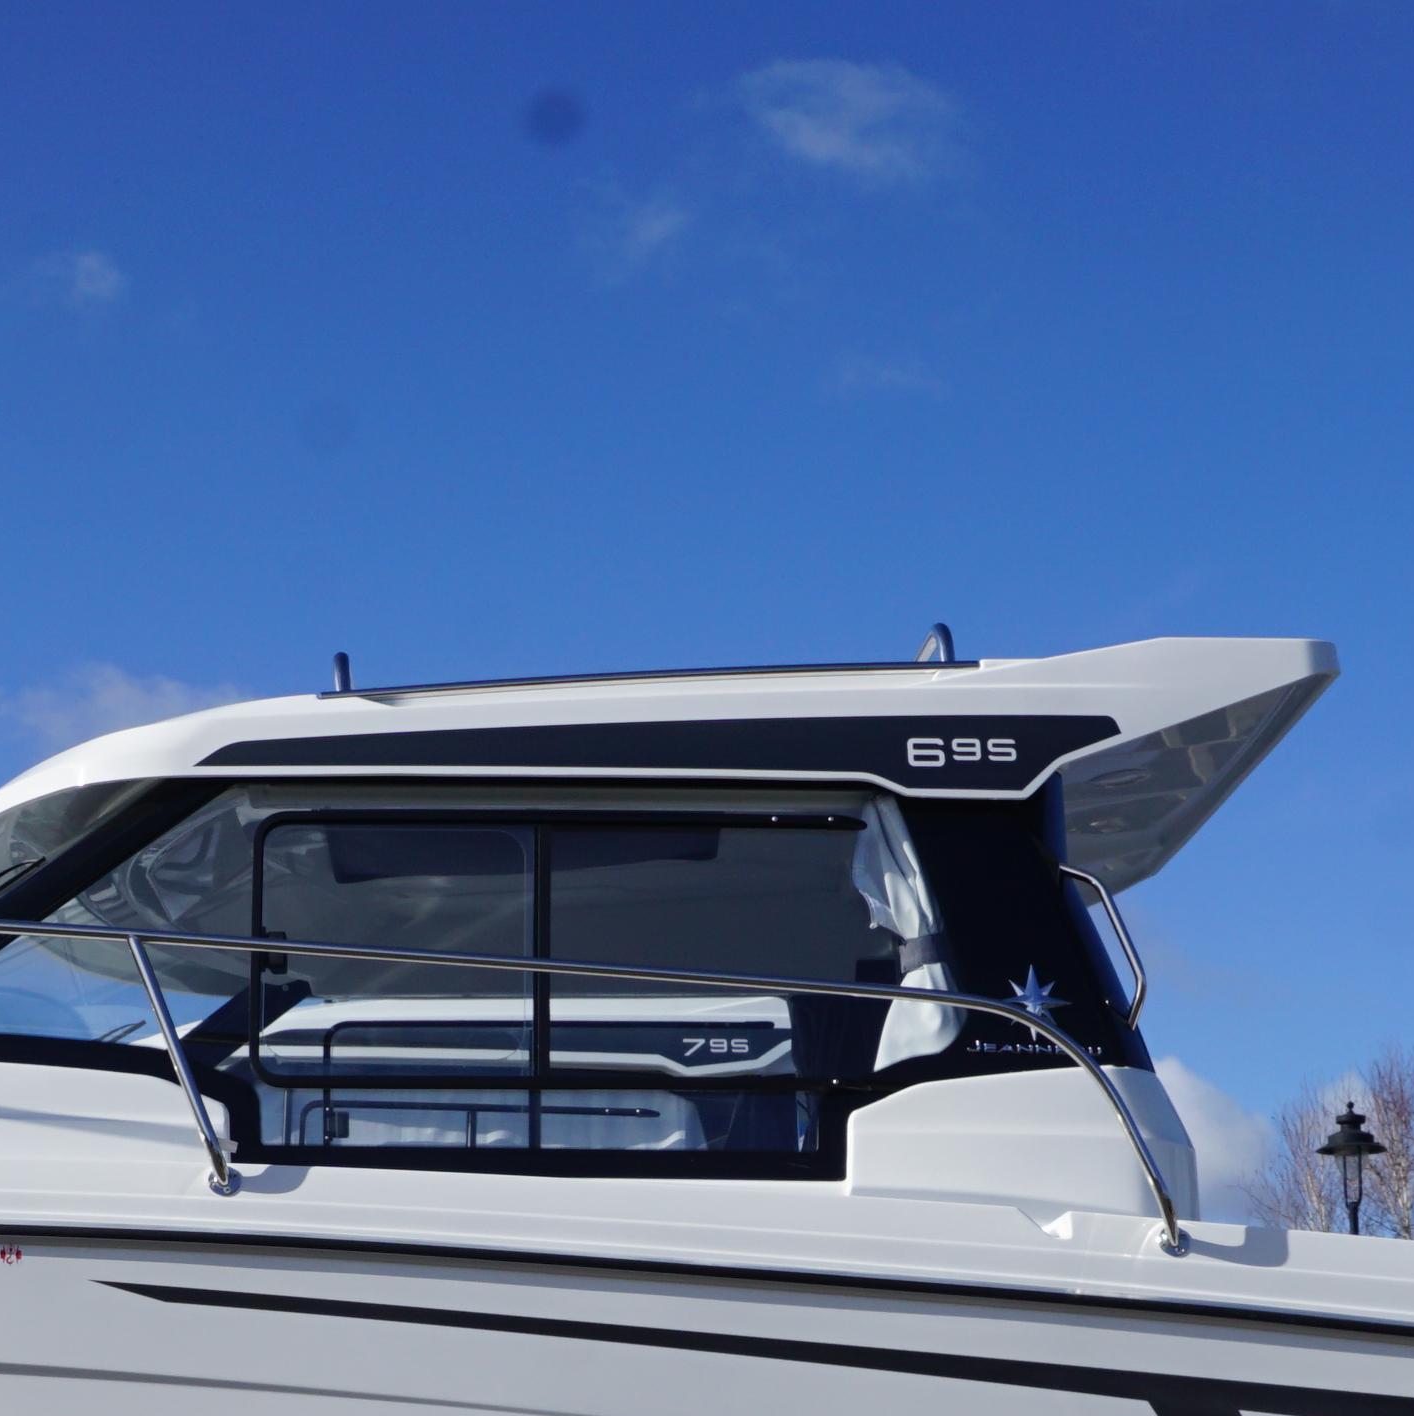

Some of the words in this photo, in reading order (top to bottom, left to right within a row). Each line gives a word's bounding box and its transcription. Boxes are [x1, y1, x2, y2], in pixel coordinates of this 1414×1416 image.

[906, 737, 1017, 767] 695
[682, 1038, 749, 1056] 795
[966, 1039, 1102, 1056] JEANNEU
